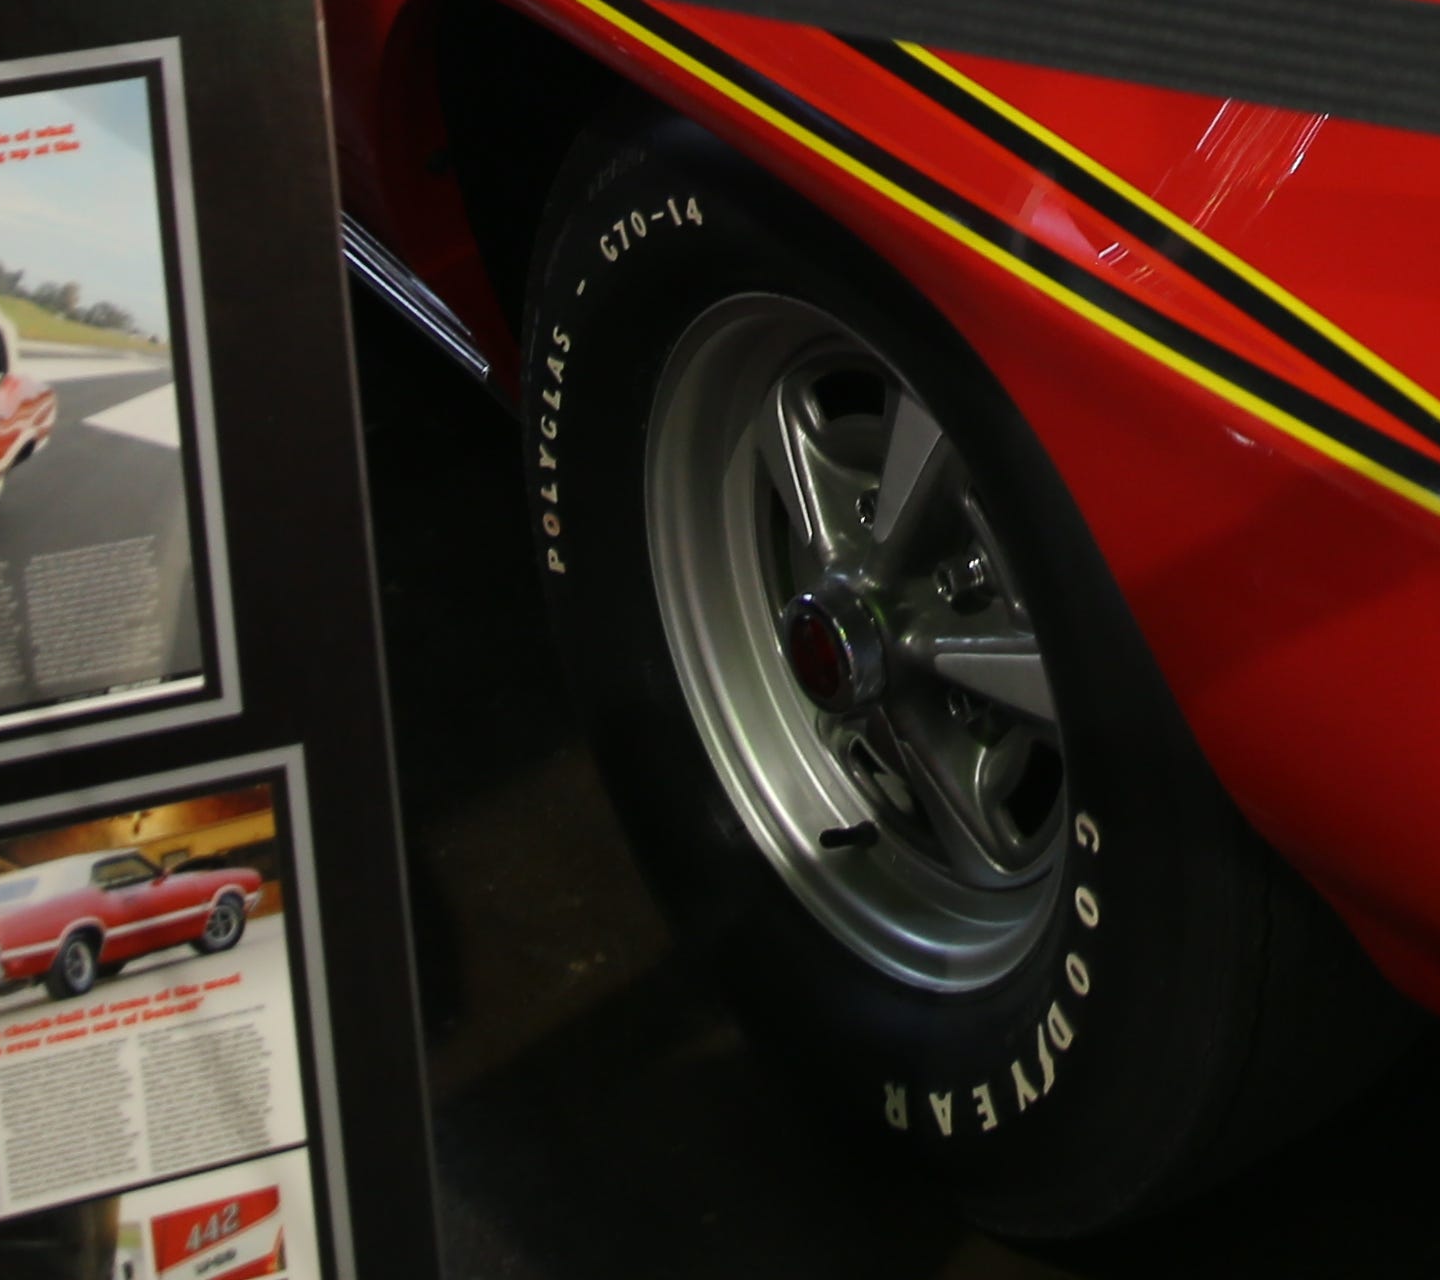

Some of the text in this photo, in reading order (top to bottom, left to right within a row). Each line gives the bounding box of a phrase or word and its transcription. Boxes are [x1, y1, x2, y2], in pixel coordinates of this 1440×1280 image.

[539, 325, 571, 574] POLYGLAS
[600, 196, 703, 262] G70-14
[884, 811, 1100, 1137] GOODYEAR
